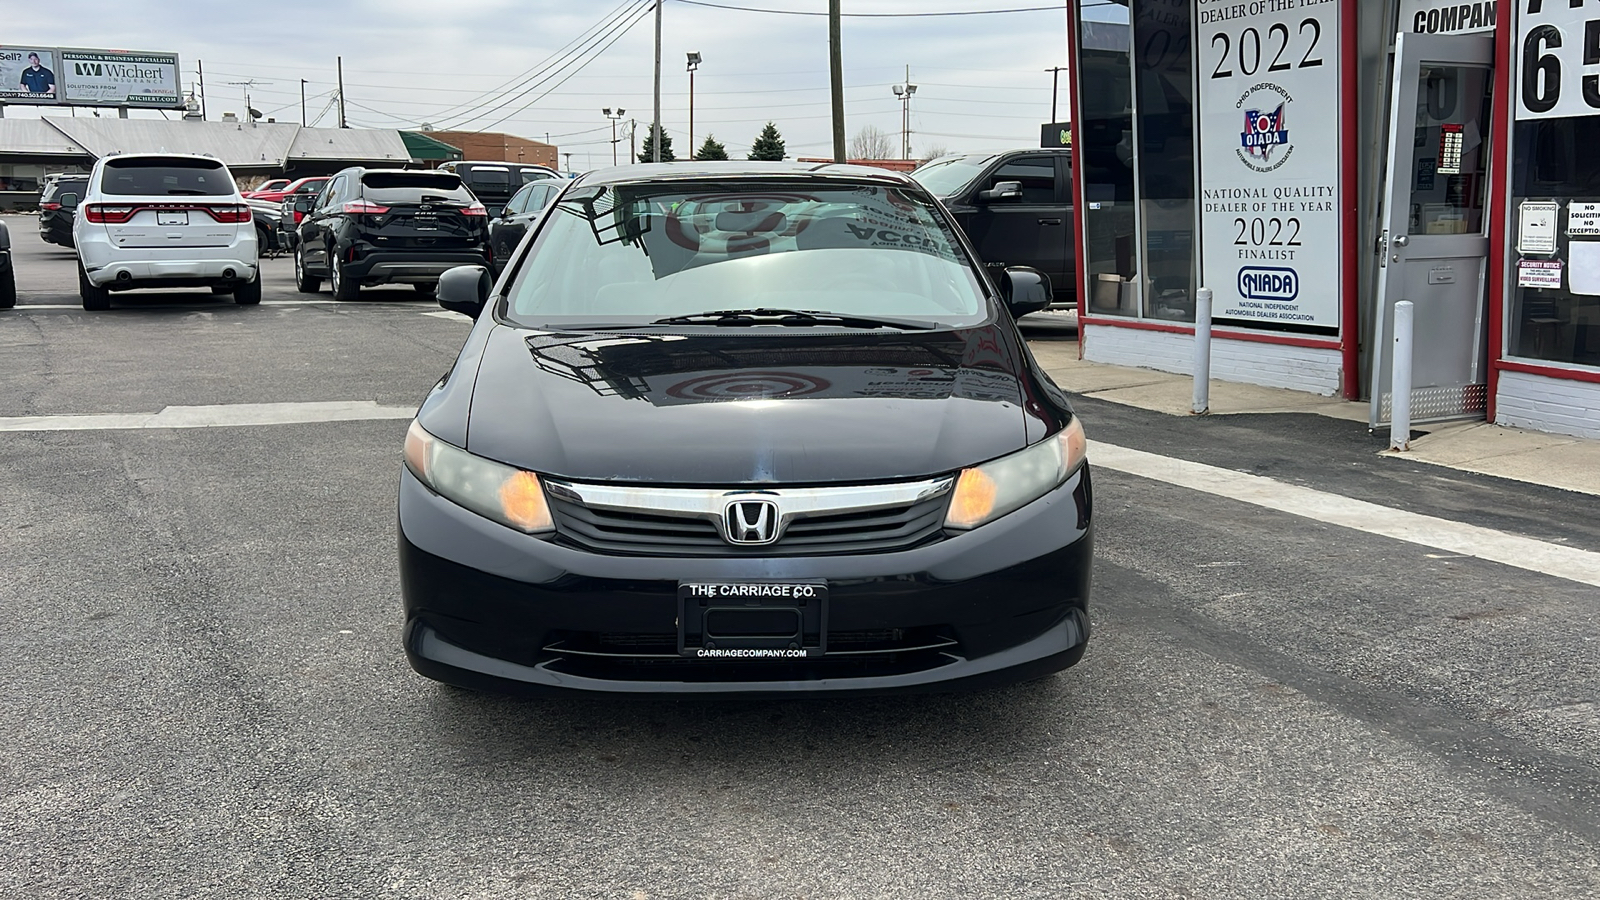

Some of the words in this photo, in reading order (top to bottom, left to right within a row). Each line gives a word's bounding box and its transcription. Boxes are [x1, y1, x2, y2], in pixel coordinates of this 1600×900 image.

[1200, 4, 1247, 24] DEALER
[1250, 1, 1266, 15] OF
[1268, 0, 1294, 12] THE
[1413, 1, 1497, 34] COMPAN
[1210, 17, 1323, 79] 2022
[104, 63, 164, 79] Wichert
[1235, 90, 1250, 109] OHIO
[1250, 82, 1294, 104] INDEPENDENT
[1246, 132, 1280, 146] OIADA
[1235, 148, 1256, 171] AUTOMOBILE
[1255, 165, 1273, 173] DEALERS
[1273, 144, 1295, 170] ASSOCIATION
[1204, 187, 1268, 200] NATIONAL
[1273, 186, 1335, 200] QUALITY
[1205, 202, 1248, 213] DEALER
[1252, 202, 1267, 212] OF
[1271, 202, 1295, 212] THE
[1300, 201, 1333, 212] YEAR
[1233, 217, 1302, 246] 2022
[1238, 249, 1296, 260] FINALIST
[1242, 273, 1293, 295] NIADA
[1238, 301, 1263, 309] NATIONAL
[1264, 303, 1299, 311] INDEPENDENT
[1225, 309, 1256, 317] AUTOMOBILE
[1257, 310, 1278, 318] DEALERS
[1279, 312, 1315, 321] ASSOCIATION
[690, 585, 717, 596] THE
[720, 585, 790, 596] CARRIAGE
[793, 585, 817, 598] CO.
[697, 649, 808, 657] CARRIAGECOMPANY.COM
